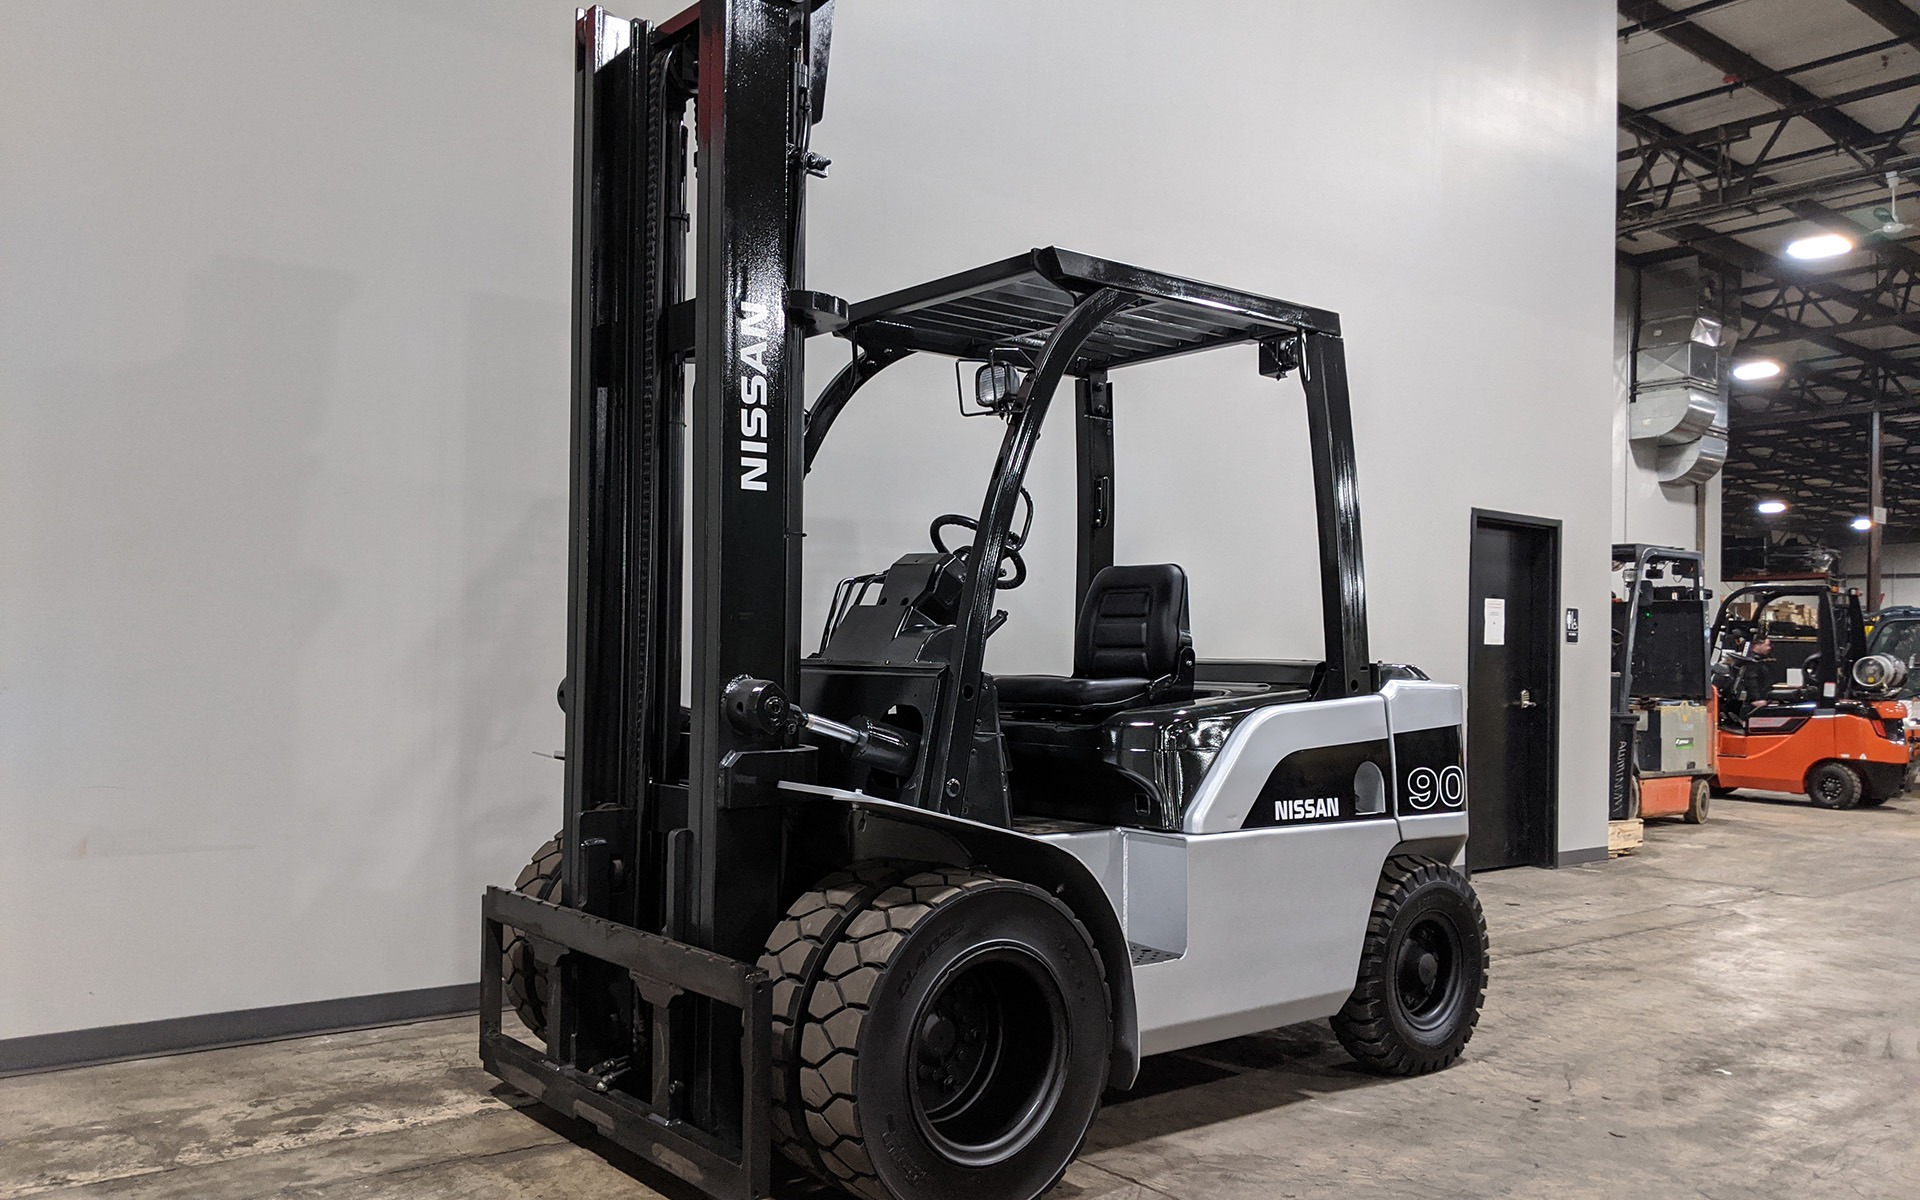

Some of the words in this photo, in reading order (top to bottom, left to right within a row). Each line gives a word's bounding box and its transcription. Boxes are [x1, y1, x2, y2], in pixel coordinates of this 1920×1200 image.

[740, 301, 768, 492] NISSAN
[1274, 797, 1340, 821] NISSAN
[1407, 765, 1465, 810] 90
